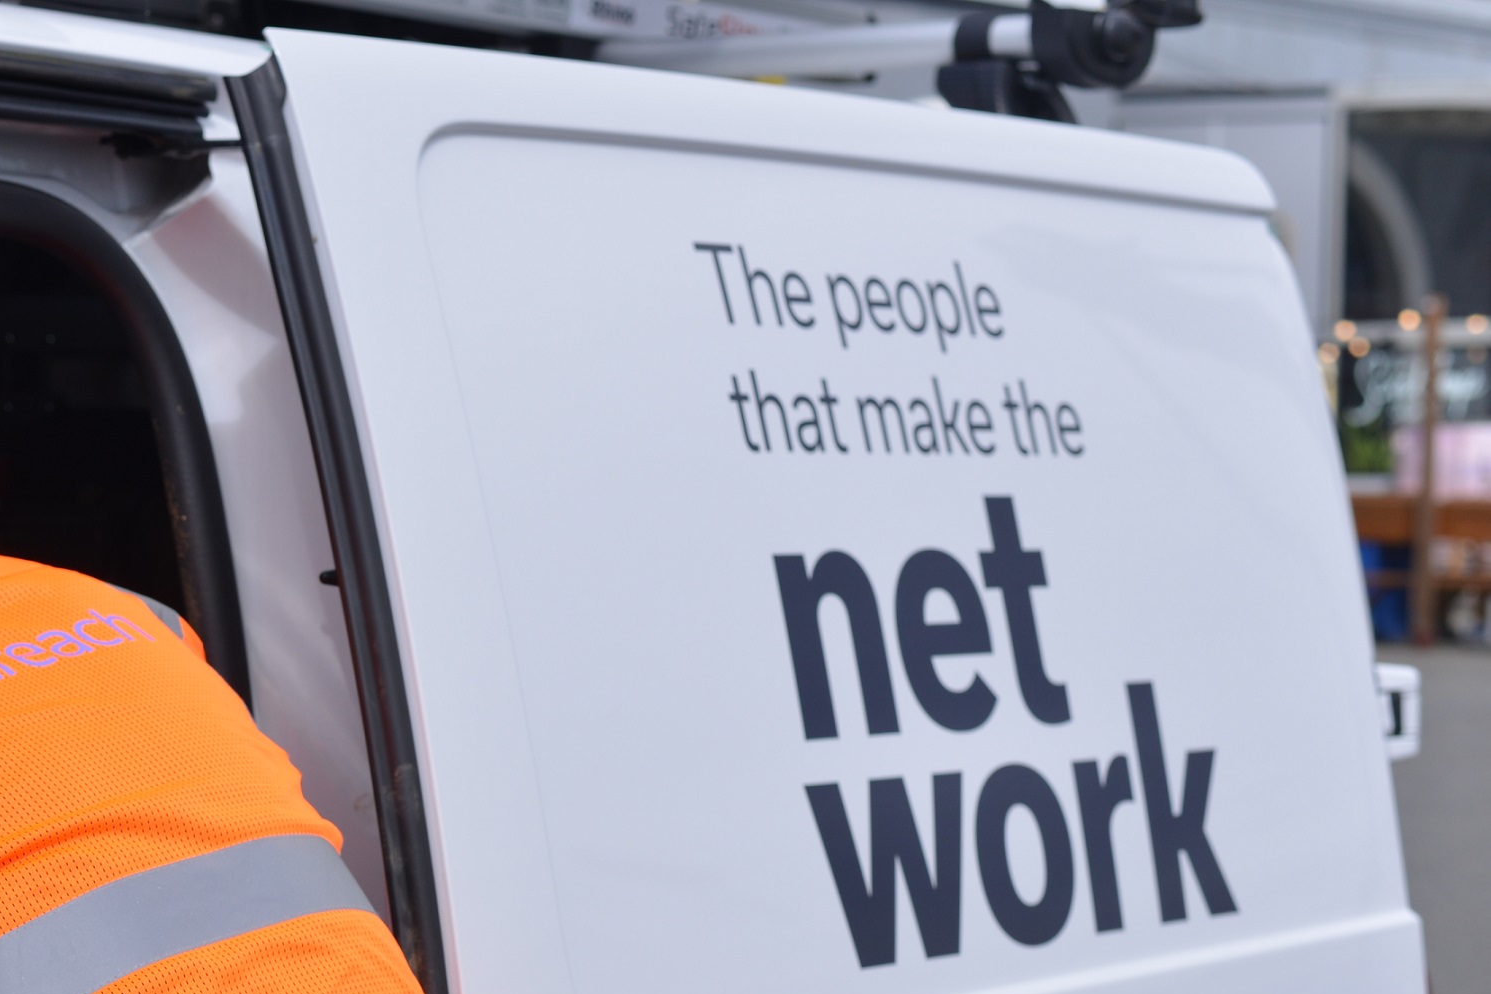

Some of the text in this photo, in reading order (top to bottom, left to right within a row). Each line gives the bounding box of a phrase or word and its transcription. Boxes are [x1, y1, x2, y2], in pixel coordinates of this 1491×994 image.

[693, 241, 1004, 353] The people
[728, 368, 1086, 457] that make the
[772, 495, 1072, 741] net
[804, 680, 1239, 969] work
